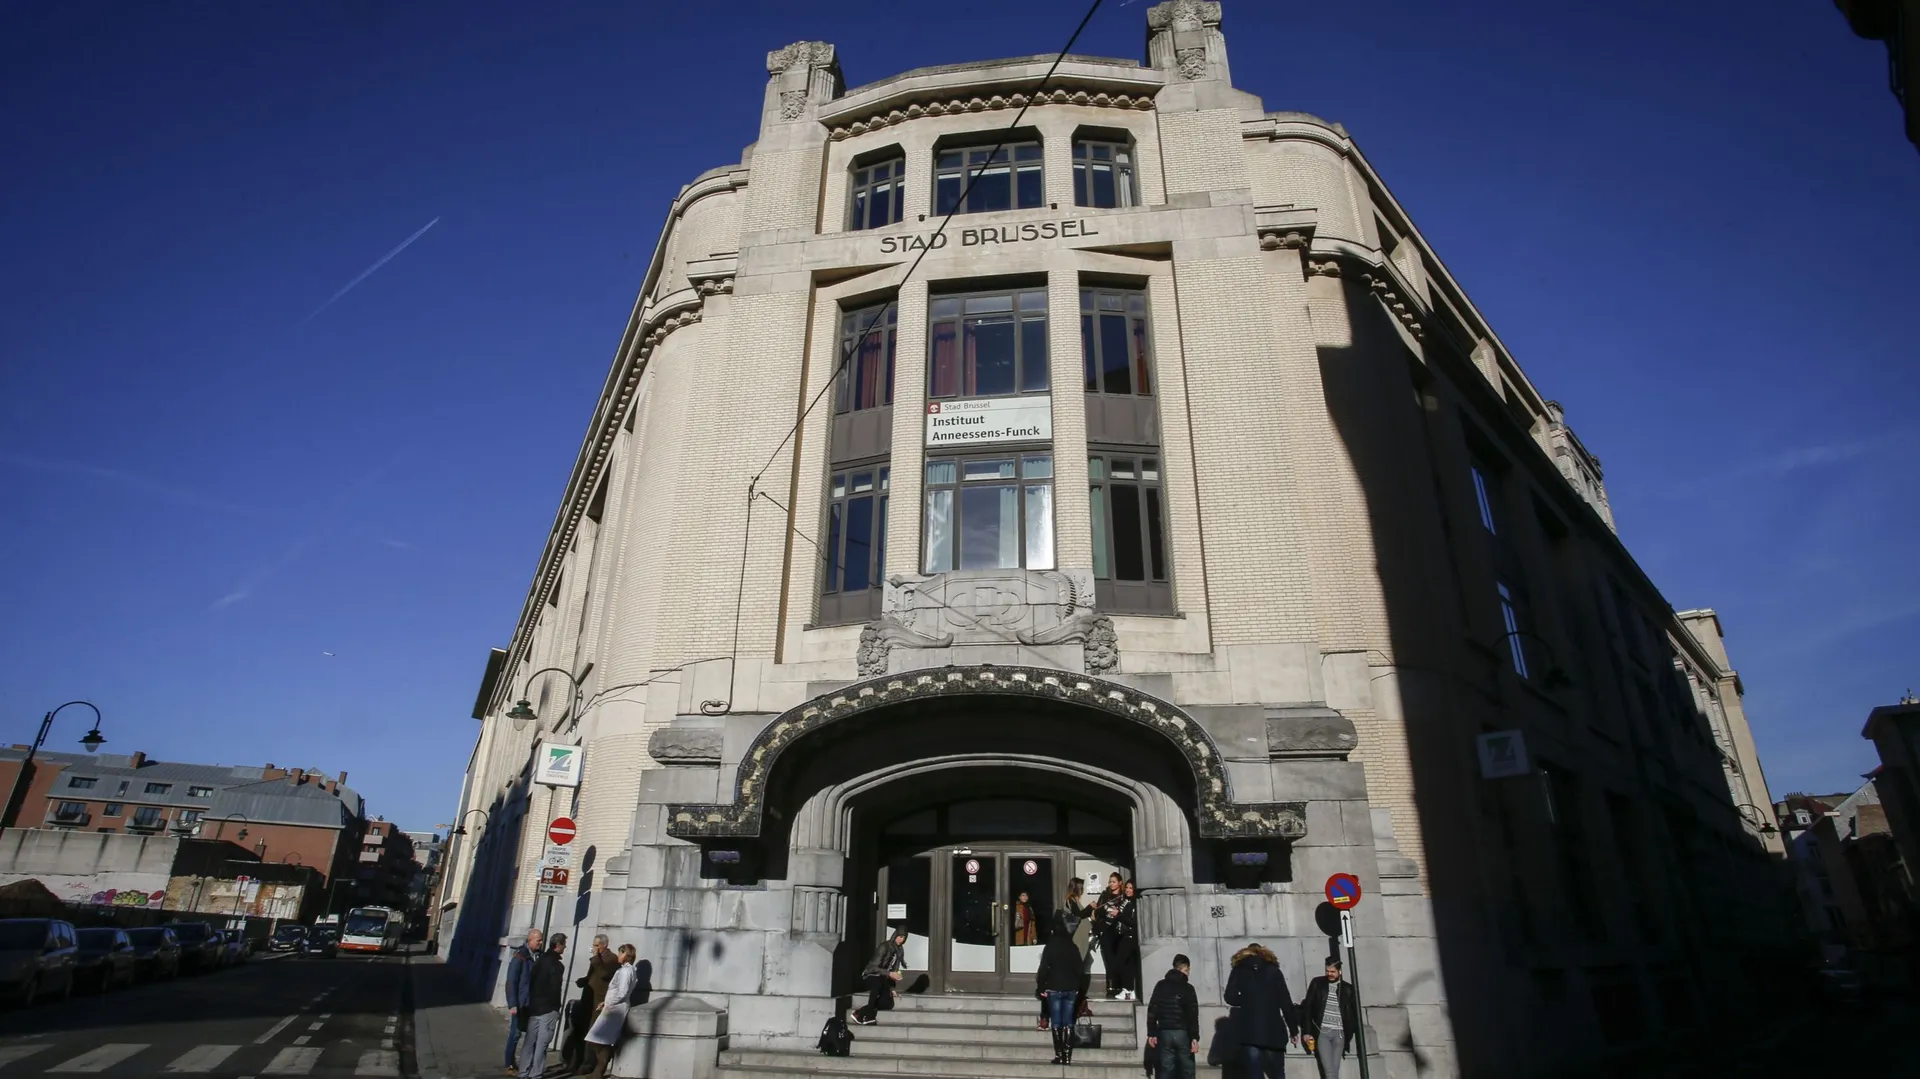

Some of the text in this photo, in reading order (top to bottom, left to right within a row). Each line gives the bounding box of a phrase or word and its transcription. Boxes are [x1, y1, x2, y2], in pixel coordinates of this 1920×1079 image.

[880, 219, 1099, 254] STAD BRUSSEL
[944, 401, 991, 411] Stad Brussel
[932, 415, 985, 427] Instituut
[932, 426, 1041, 441] Anneessens-Funck
